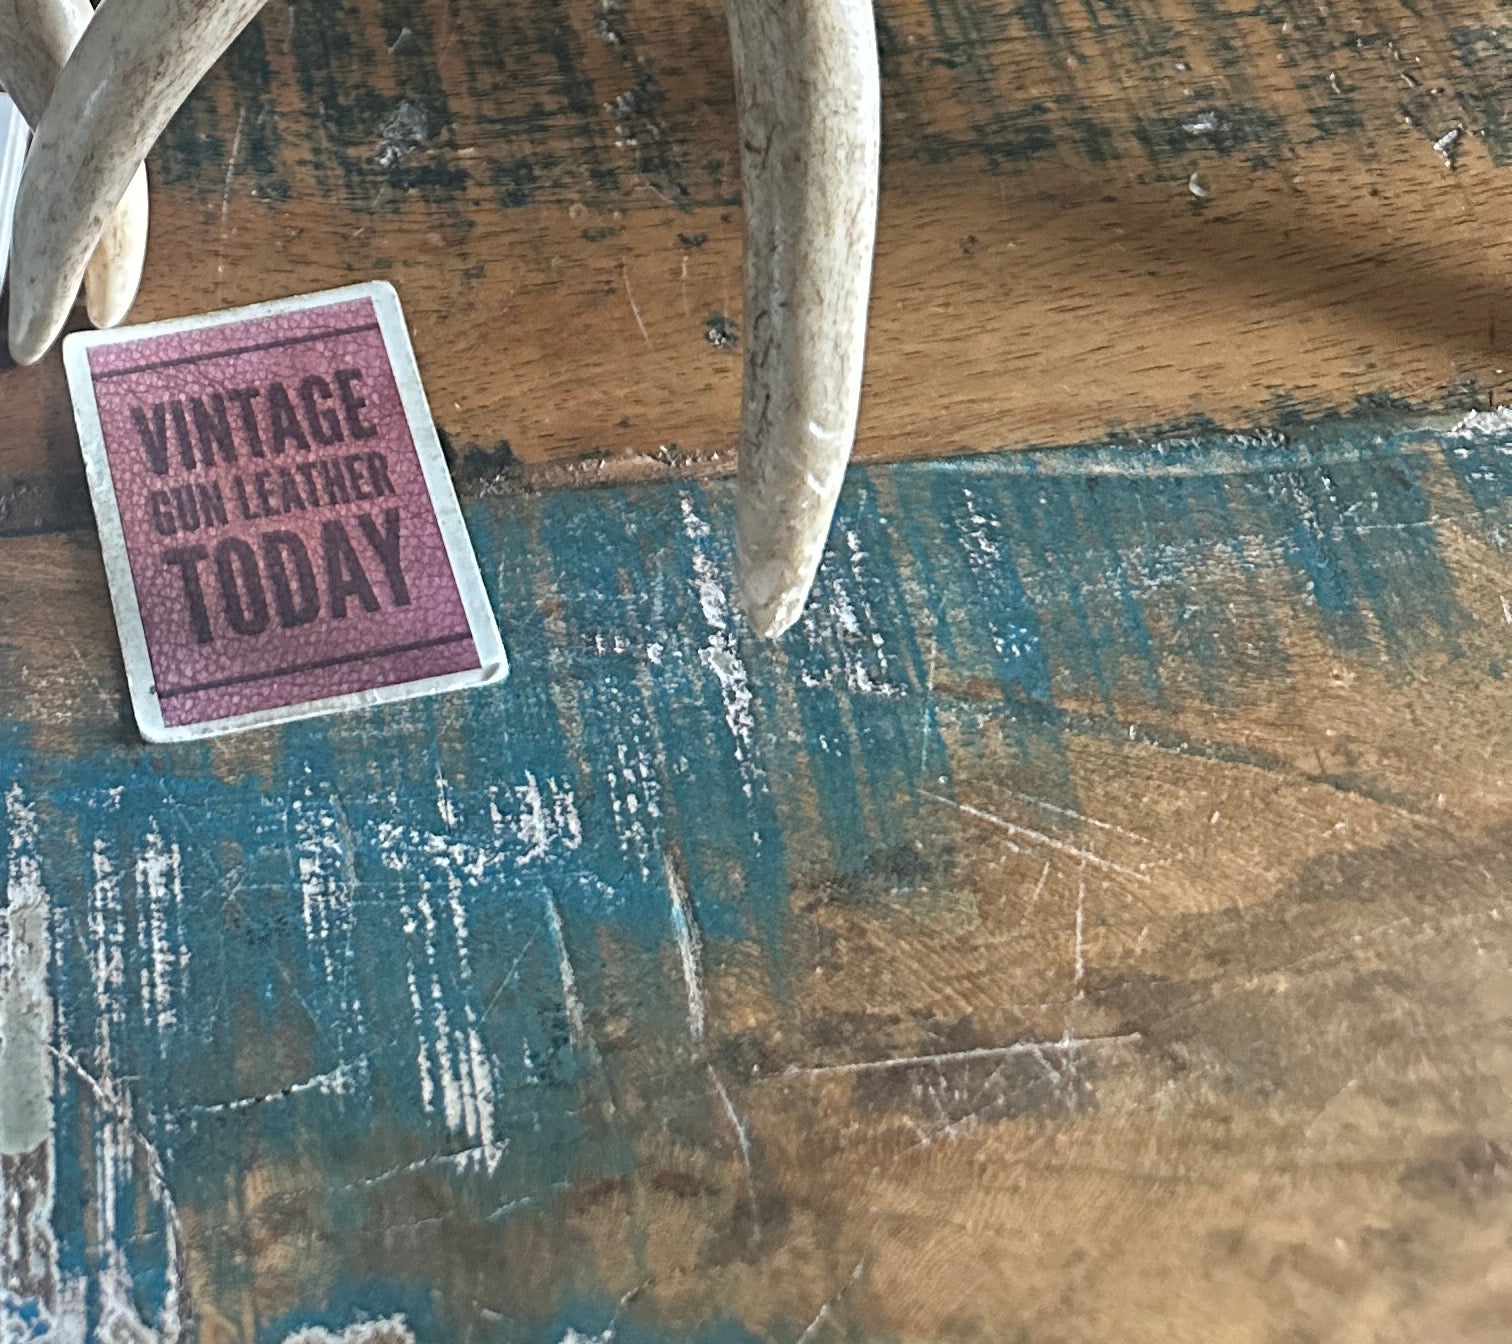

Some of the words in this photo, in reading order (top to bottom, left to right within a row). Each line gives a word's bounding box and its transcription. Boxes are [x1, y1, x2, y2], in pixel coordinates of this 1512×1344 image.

[130, 367, 378, 476] VINTAGE
[146, 480, 229, 537] GUN
[234, 450, 397, 521] LEATHER
[160, 507, 413, 645] TODAY
